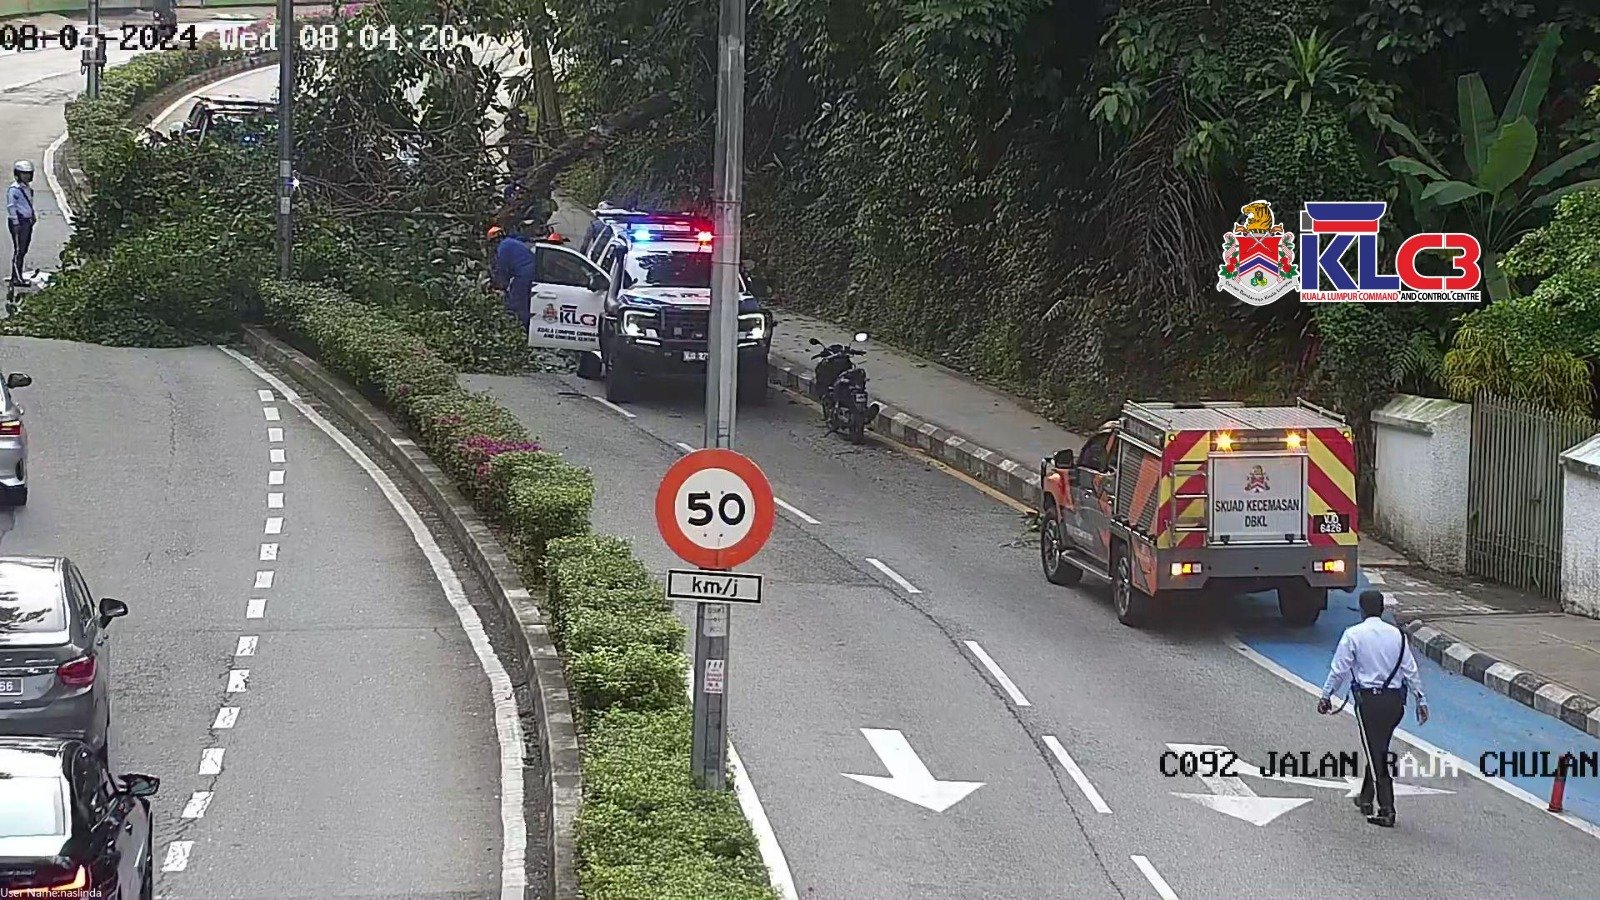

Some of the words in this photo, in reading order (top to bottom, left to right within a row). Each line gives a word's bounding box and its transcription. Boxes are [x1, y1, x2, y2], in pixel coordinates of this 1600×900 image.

[687, 493, 746, 526] 50
[1215, 500, 1245, 512] SKUAD
[1246, 499, 1300, 512] KECEMASAN
[1244, 515, 1268, 528] DBKL
[1320, 523, 1342, 534] 6426
[692, 576, 738, 597] km/j
